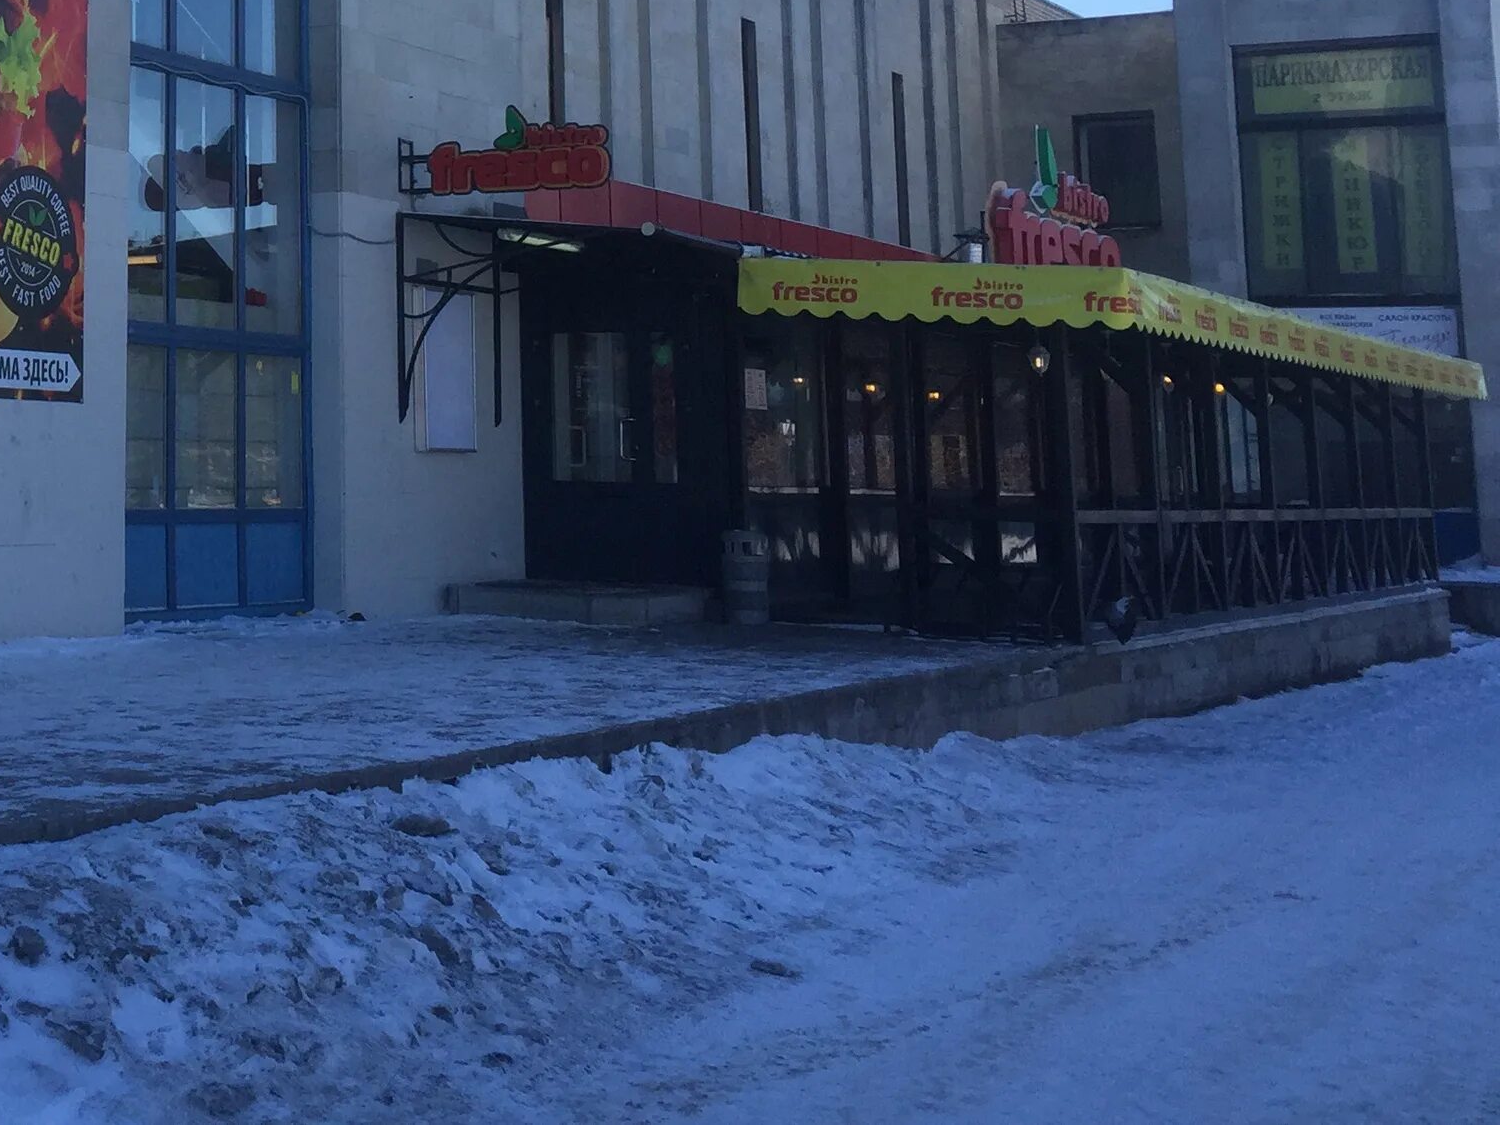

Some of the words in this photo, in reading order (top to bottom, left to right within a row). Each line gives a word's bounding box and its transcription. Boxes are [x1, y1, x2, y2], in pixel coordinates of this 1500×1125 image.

[428, 141, 611, 195] fresco
[20, 175, 53, 209] QUALITY
[49, 192, 71, 237] COFFEE
[2, 217, 61, 267] FRESCO
[11, 283, 35, 307] FAST
[38, 274, 61, 305] FOOD
[772, 280, 858, 303] fresco
[931, 286, 1024, 310] fresco
[23, 358, 69, 385] ЗДЕСЬ!
